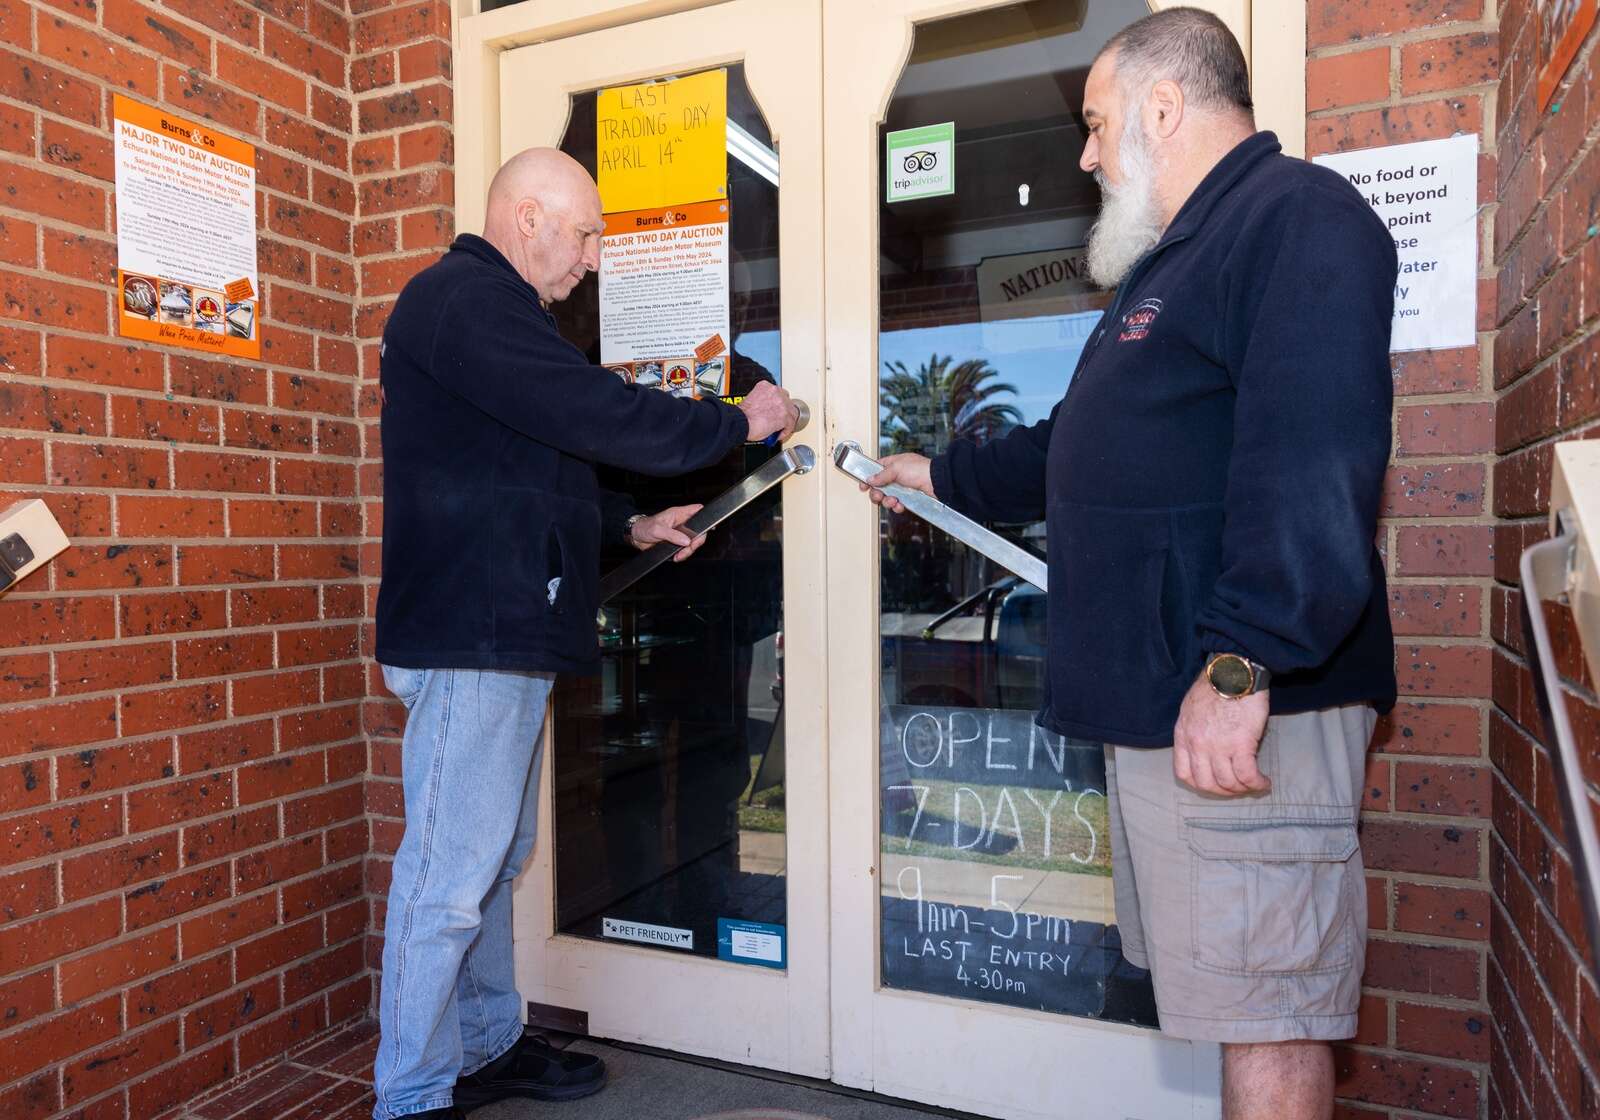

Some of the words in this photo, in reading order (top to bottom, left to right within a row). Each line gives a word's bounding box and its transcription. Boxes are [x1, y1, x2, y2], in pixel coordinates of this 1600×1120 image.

[620, 83, 671, 110] LAST
[599, 112, 667, 140] TRADING
[683, 103, 710, 131] DAY
[161, 120, 215, 147] Burns&Co
[121, 125, 159, 147] MAJOR
[162, 139, 185, 156] TWO
[188, 148, 207, 164] DAY
[210, 156, 249, 178] AUCTION
[601, 144, 647, 171] APRIL
[122, 140, 147, 154] Echuca
[150, 149, 177, 164] National
[179, 159, 202, 172] Holden
[204, 168, 222, 179] Motor
[224, 174, 249, 188] Museum
[894, 175, 943, 190] tripadvisor
[1350, 173, 1371, 185] No
[1376, 166, 1414, 182] food
[1420, 166, 1437, 177] or
[1385, 185, 1447, 204] beyond
[636, 211, 687, 226] Burns&Co
[1388, 211, 1431, 230] point
[602, 237, 633, 247] MAJOR
[637, 234, 657, 244] TWO
[660, 232, 677, 241] DAY
[681, 227, 722, 239] AUCTION
[604, 250, 624, 258] Echuca
[625, 247, 649, 255] National
[651, 245, 673, 253] Holden
[675, 242, 692, 250] Motor
[695, 240, 721, 248] Museum
[1399, 309, 1420, 318] you
[902, 712, 1066, 774] OPEN
[619, 925, 635, 936] PET
[638, 928, 680, 942] FRIENDLY
[904, 936, 972, 962] LAST
[989, 945, 1071, 976] ENTRY
